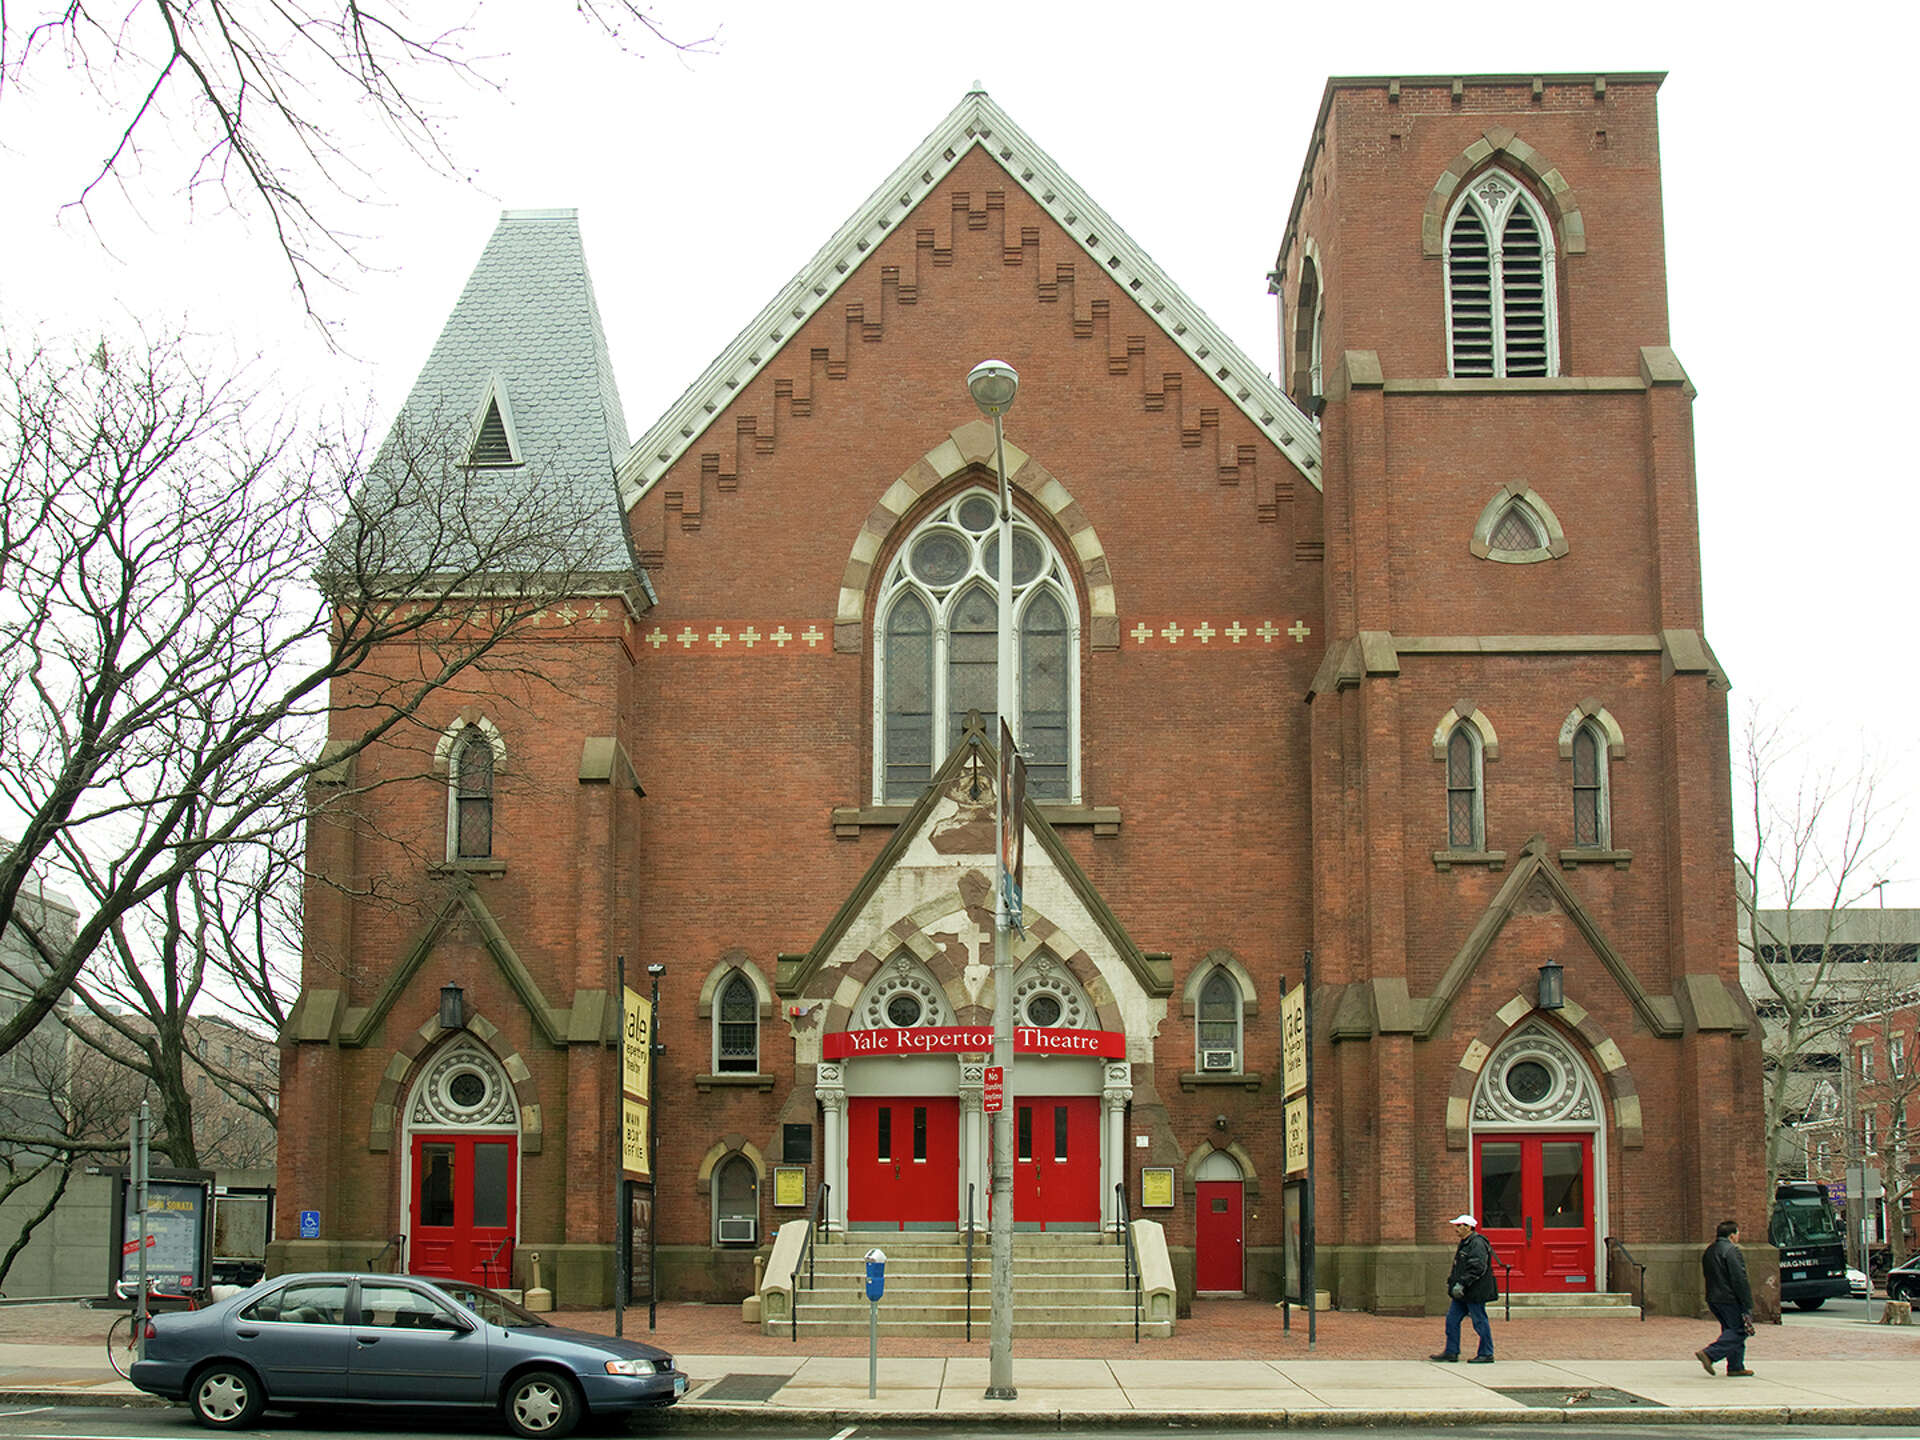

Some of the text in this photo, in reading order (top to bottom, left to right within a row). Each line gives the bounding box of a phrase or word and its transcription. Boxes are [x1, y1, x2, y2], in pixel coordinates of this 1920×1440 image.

[850, 1028, 1100, 1051] Yale Repertor Theatre
[988, 1072, 998, 1081] No
[1779, 1259, 1819, 1268] WAGNER
